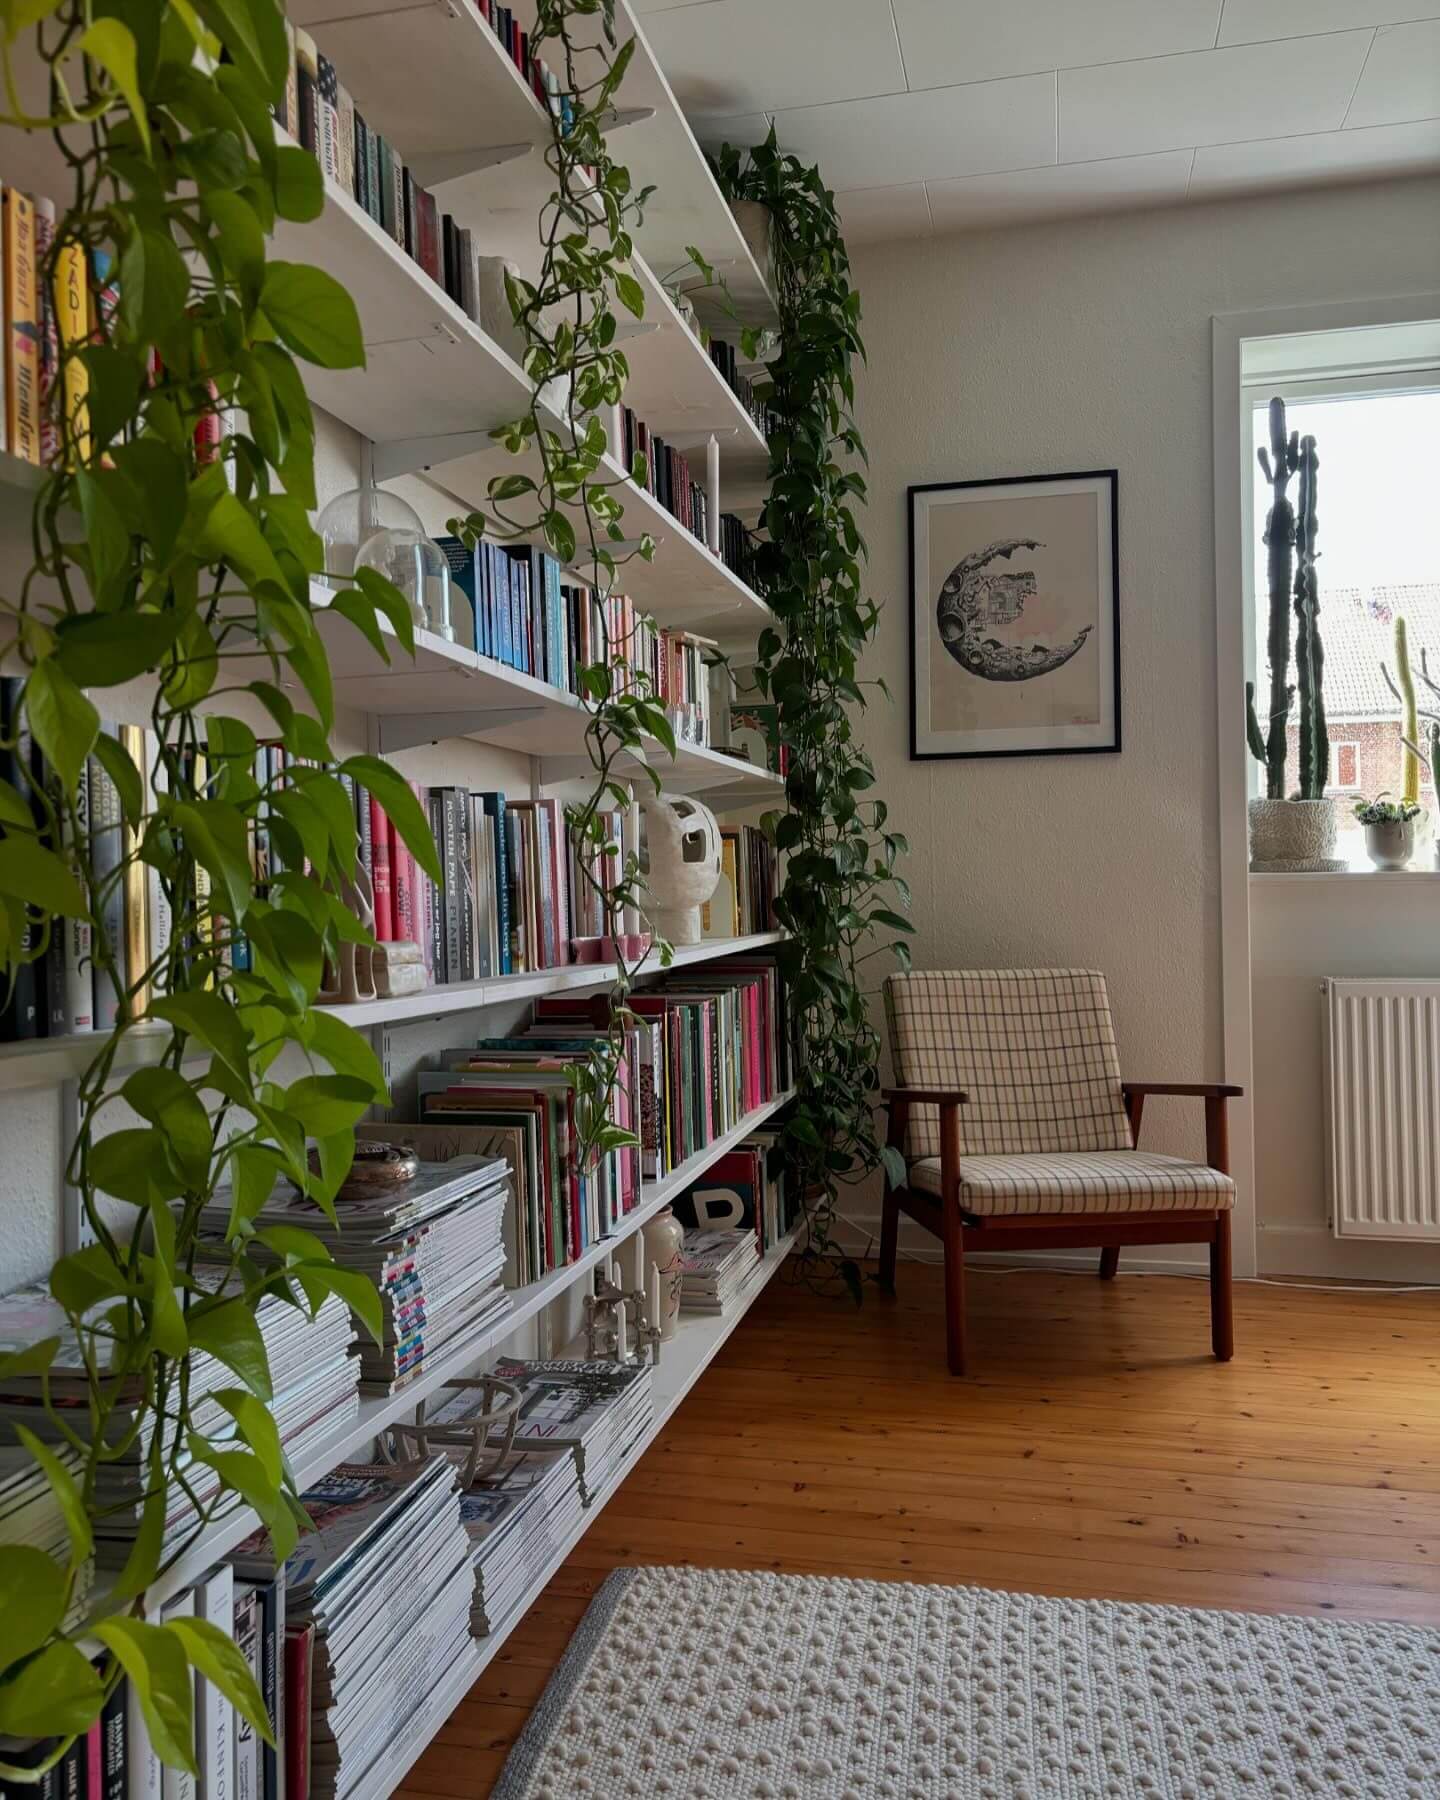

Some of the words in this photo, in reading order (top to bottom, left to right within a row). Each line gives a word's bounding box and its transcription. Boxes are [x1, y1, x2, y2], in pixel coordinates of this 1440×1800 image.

[67, 245, 82, 346] ZADI
[17, 363, 34, 460] Hjemfær
[92, 764, 101, 822] KVINDE
[446, 799, 455, 857] MORTEN
[498, 799, 506, 852] Kvinde
[397, 876, 405, 917] NOW!
[448, 861, 456, 897] PAPE
[500, 853, 508, 889] kend
[157, 904, 166, 949] Halliday
[450, 904, 458, 970] PLANEN
[502, 921, 510, 958] krop
[114, 1711, 123, 1772] DANSKE
[215, 1722, 226, 1799] KINFO
